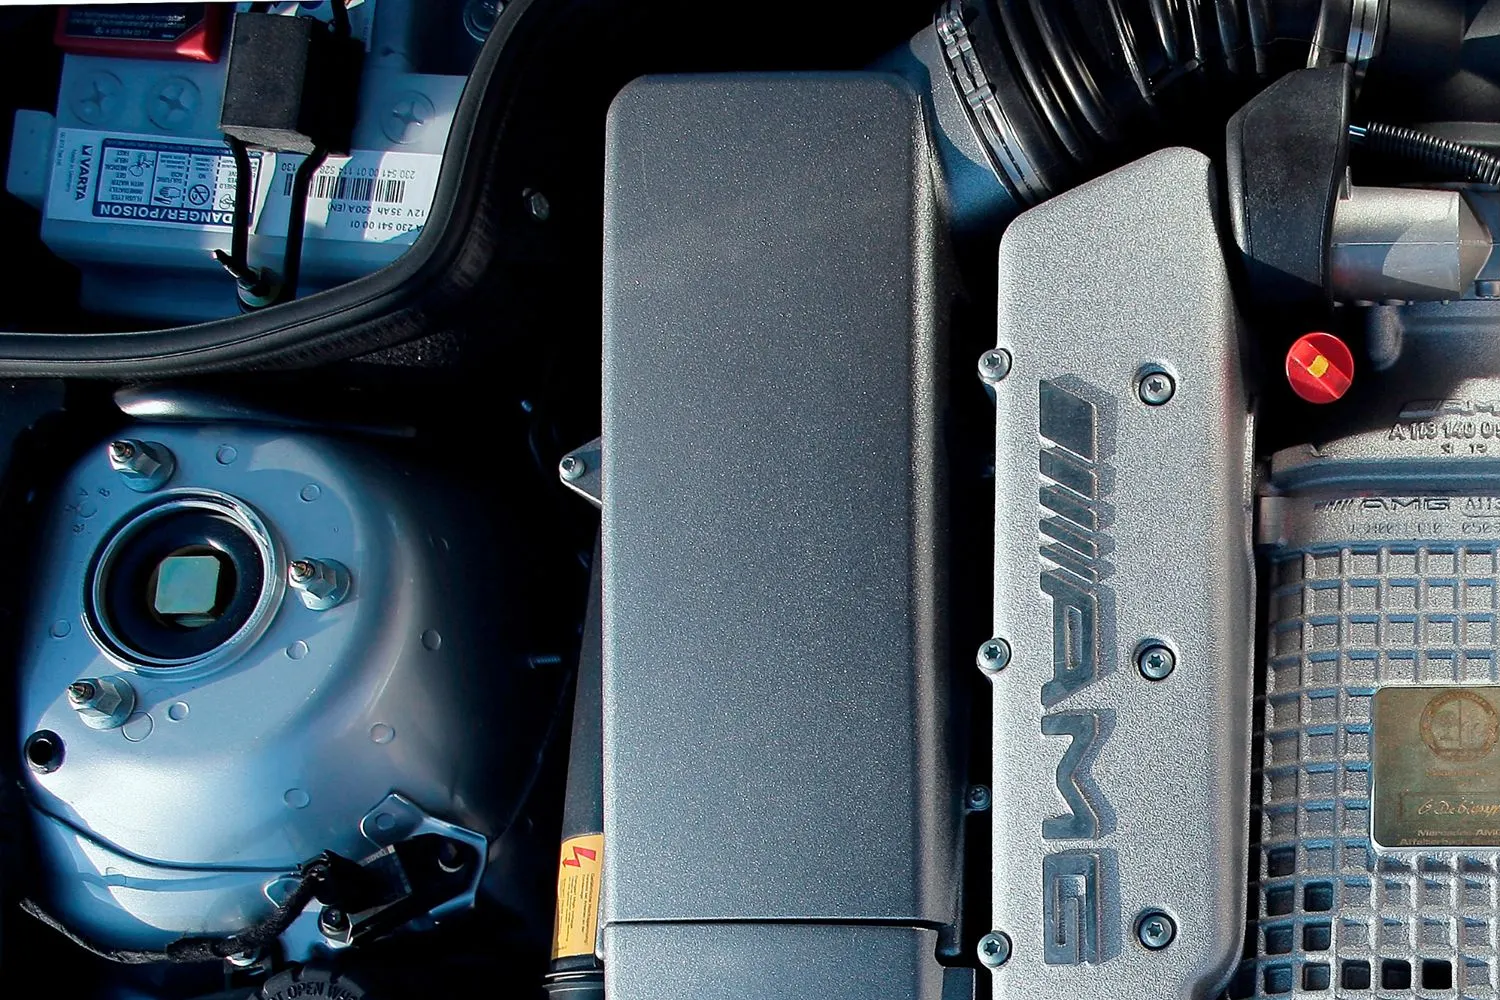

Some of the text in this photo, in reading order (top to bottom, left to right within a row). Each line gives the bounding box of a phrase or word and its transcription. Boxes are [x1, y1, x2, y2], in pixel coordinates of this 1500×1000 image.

[356, 167, 367, 177] 01
[382, 168, 397, 178] 541
[400, 169, 416, 179] 230
[75, 159, 91, 201] VARTA
[100, 204, 233, 224] DANGER/POISON
[350, 220, 361, 229] 01
[362, 221, 375, 230] 00
[377, 222, 393, 231] 541
[396, 223, 413, 232] 230
[1360, 498, 1450, 511] AMG
[1041, 571, 1114, 966] AMG
[287, 981, 324, 1000] OPEN
